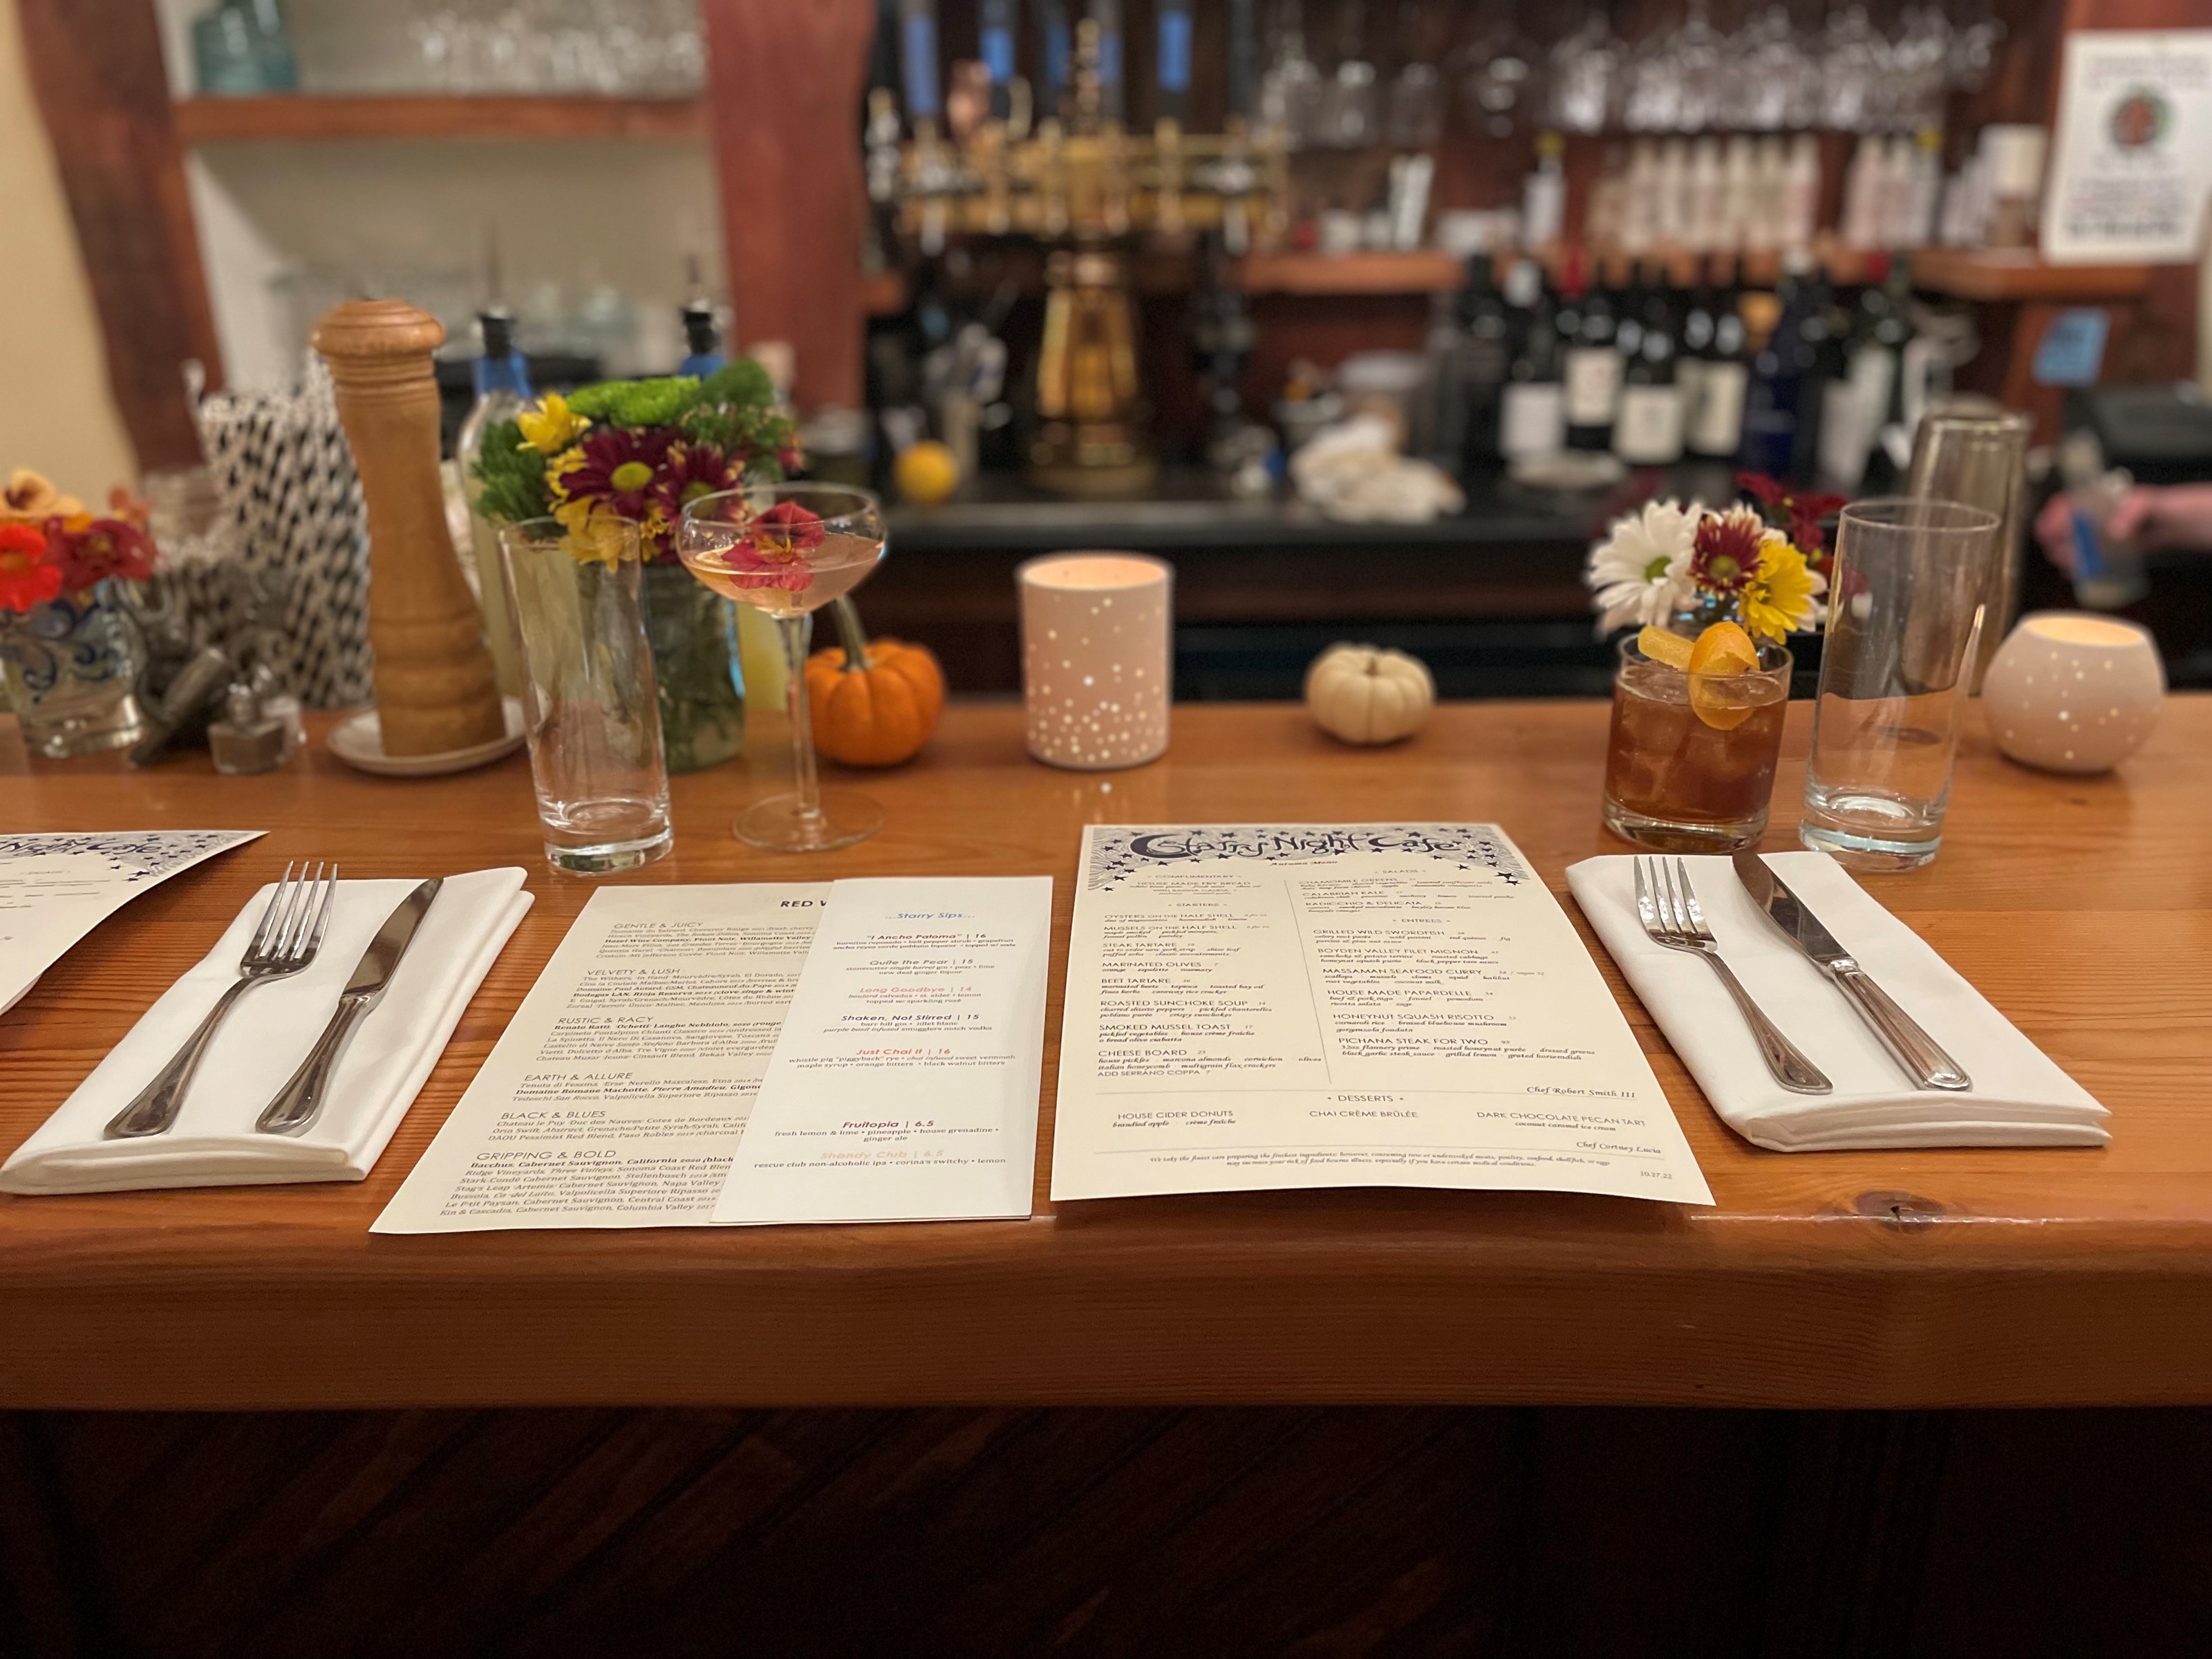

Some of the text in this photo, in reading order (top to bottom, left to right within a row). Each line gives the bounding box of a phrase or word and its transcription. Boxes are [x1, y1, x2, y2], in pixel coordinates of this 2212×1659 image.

[1130, 834, 1264, 859] Starry
[1273, 835, 1367, 854] Night
[1526, 1086, 1550, 1094] Chef
[566, 1110, 607, 1118] BLUES
[1509, 1112, 1578, 1121] CHOCOLATE
[1581, 1116, 1620, 1124] PECAN
[842, 1121, 899, 1129] Fruitopia
[1575, 1141, 1597, 1150] Chef
[1599, 1143, 1633, 1152] Cortney
[476, 1151, 553, 1161] GRIPPING
[573, 1150, 617, 1159] BOLD
[820, 1152, 871, 1160] Shandy
[875, 1150, 907, 1159] Club
